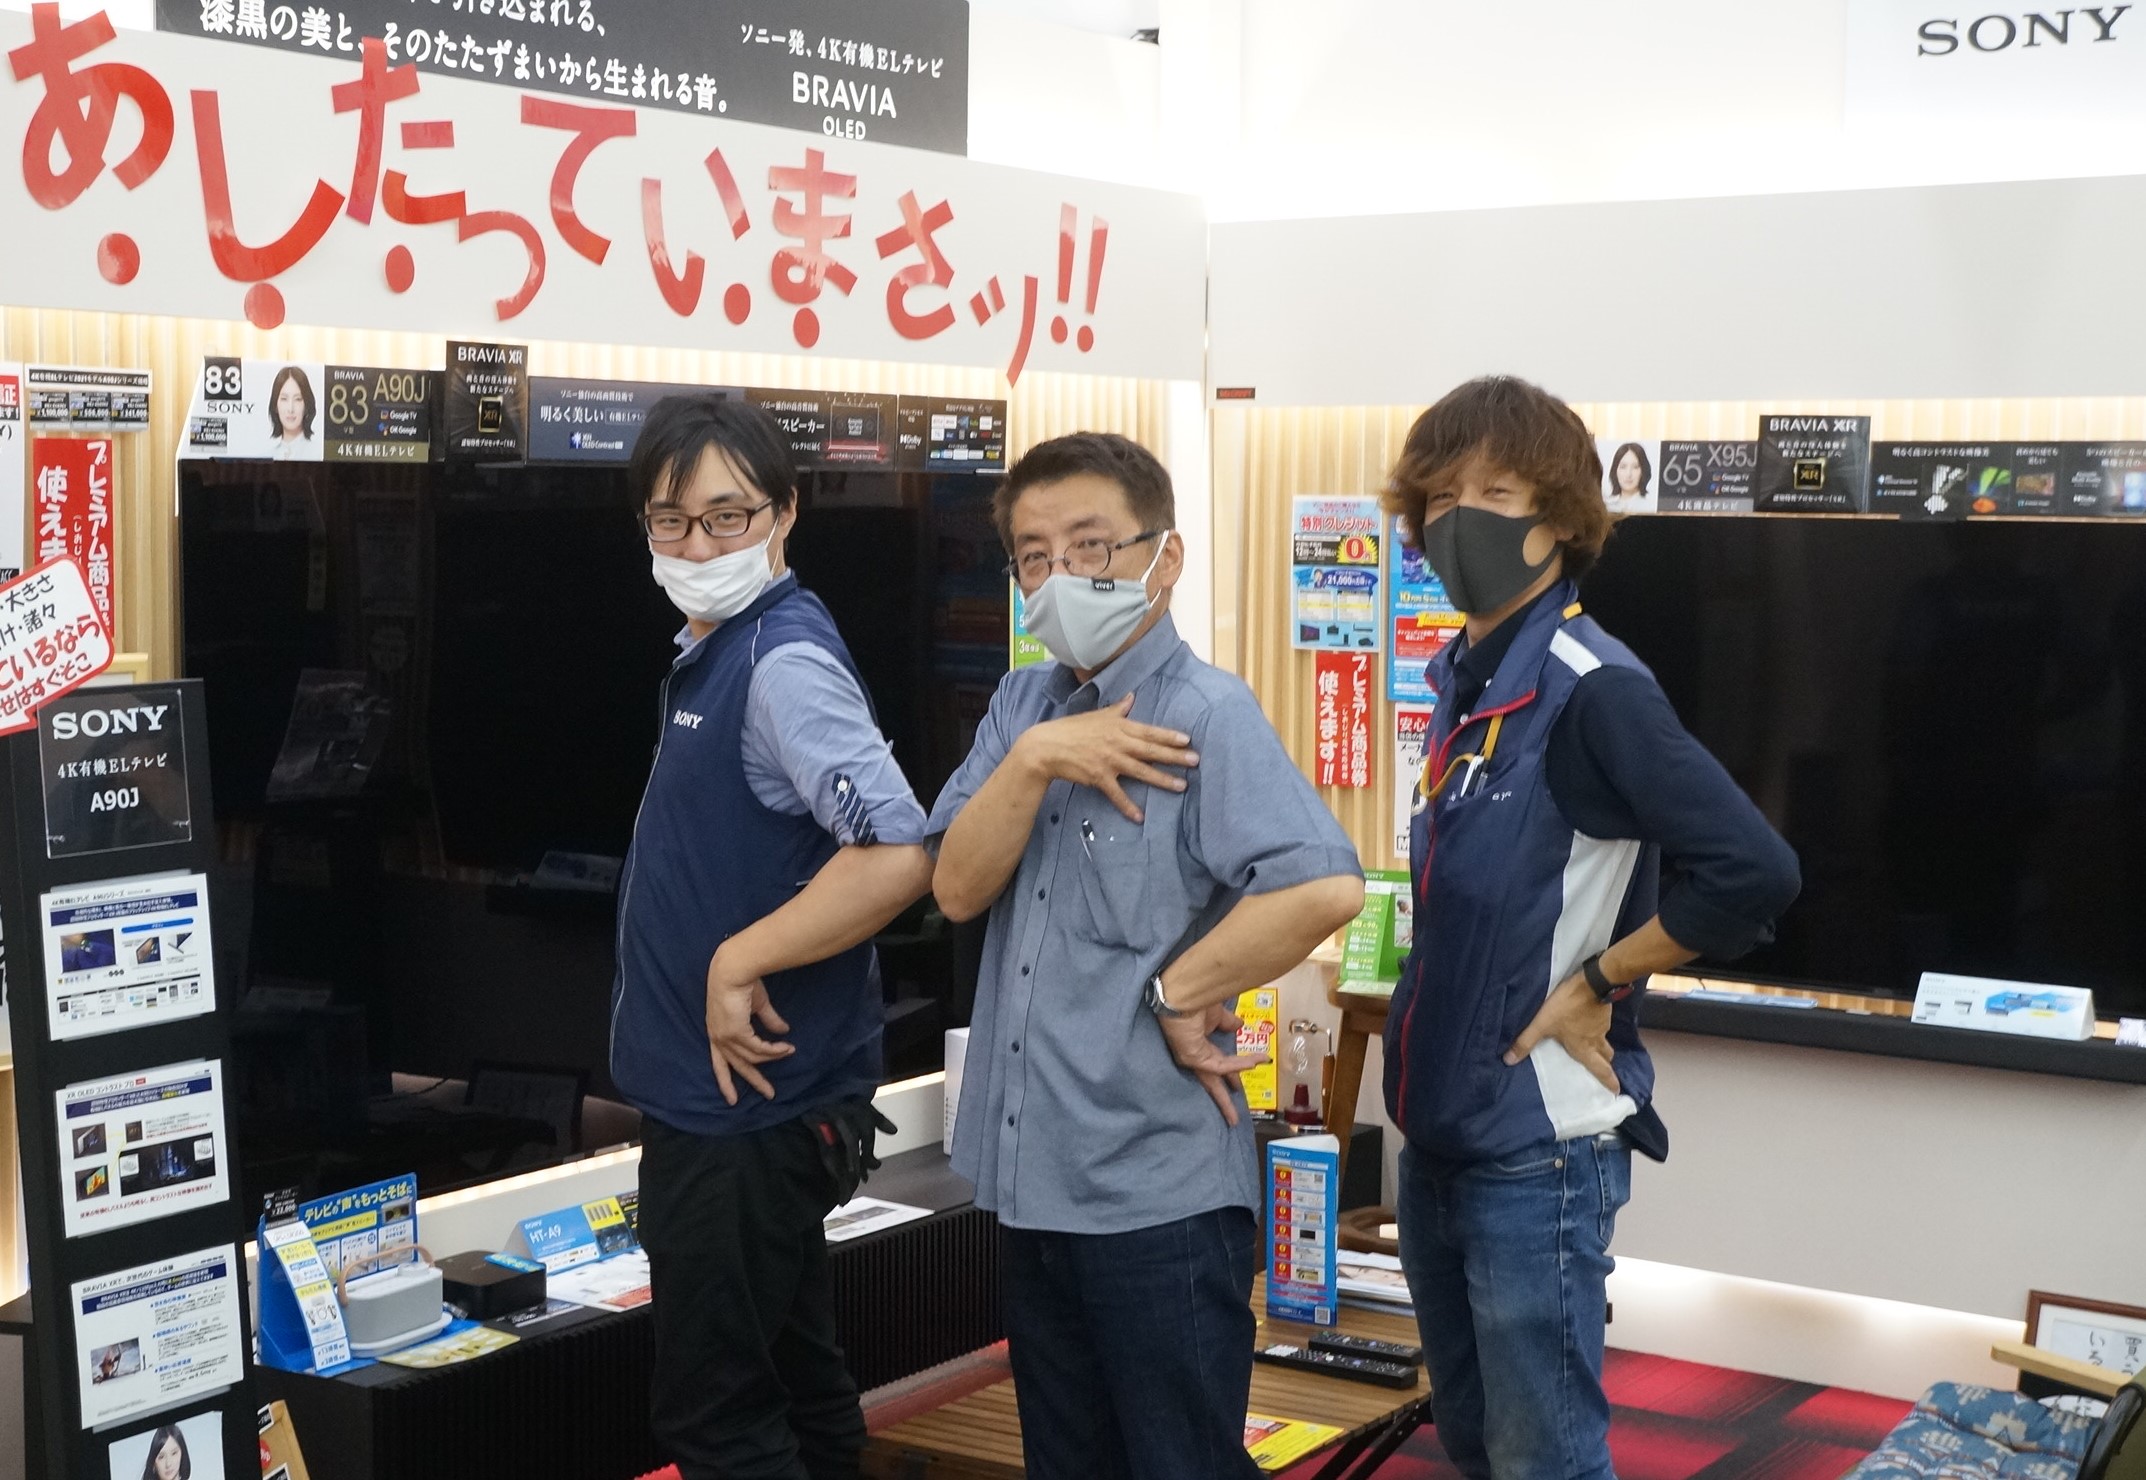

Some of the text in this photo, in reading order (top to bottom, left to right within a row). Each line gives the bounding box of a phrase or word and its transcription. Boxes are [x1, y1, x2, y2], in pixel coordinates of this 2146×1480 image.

[1917, 5, 2132, 56] SONY
[741, 23, 944, 79] ソニー発、4K有機ELテレビ
[792, 71, 897, 119] BRAVIA
[822, 115, 866, 141] OLED
[458, 346, 523, 365] BRAVIA XR
[205, 365, 241, 395] 83
[334, 370, 364, 381] BRAVIA
[373, 373, 425, 404] A90J
[206, 401, 255, 415] SONY
[329, 384, 369, 425] 83
[540, 405, 604, 423] 明るく美しい
[775, 417, 825, 434] スピーカー
[1770, 417, 1828, 433] BRAVIA
[1669, 443, 1698, 452] BRAVIA
[1706, 442, 1757, 469] X95J
[1662, 454, 1702, 487] 65
[1301, 514, 1377, 534] 特別クレジット
[0, 652, 92, 718] せはすぐそこ
[52, 705, 168, 740] SONY
[673, 709, 703, 731] SONY
[57, 753, 168, 779] 4K有機ELテレビ
[90, 787, 140, 813] A90J
[529, 1224, 562, 1244] HT-A9
